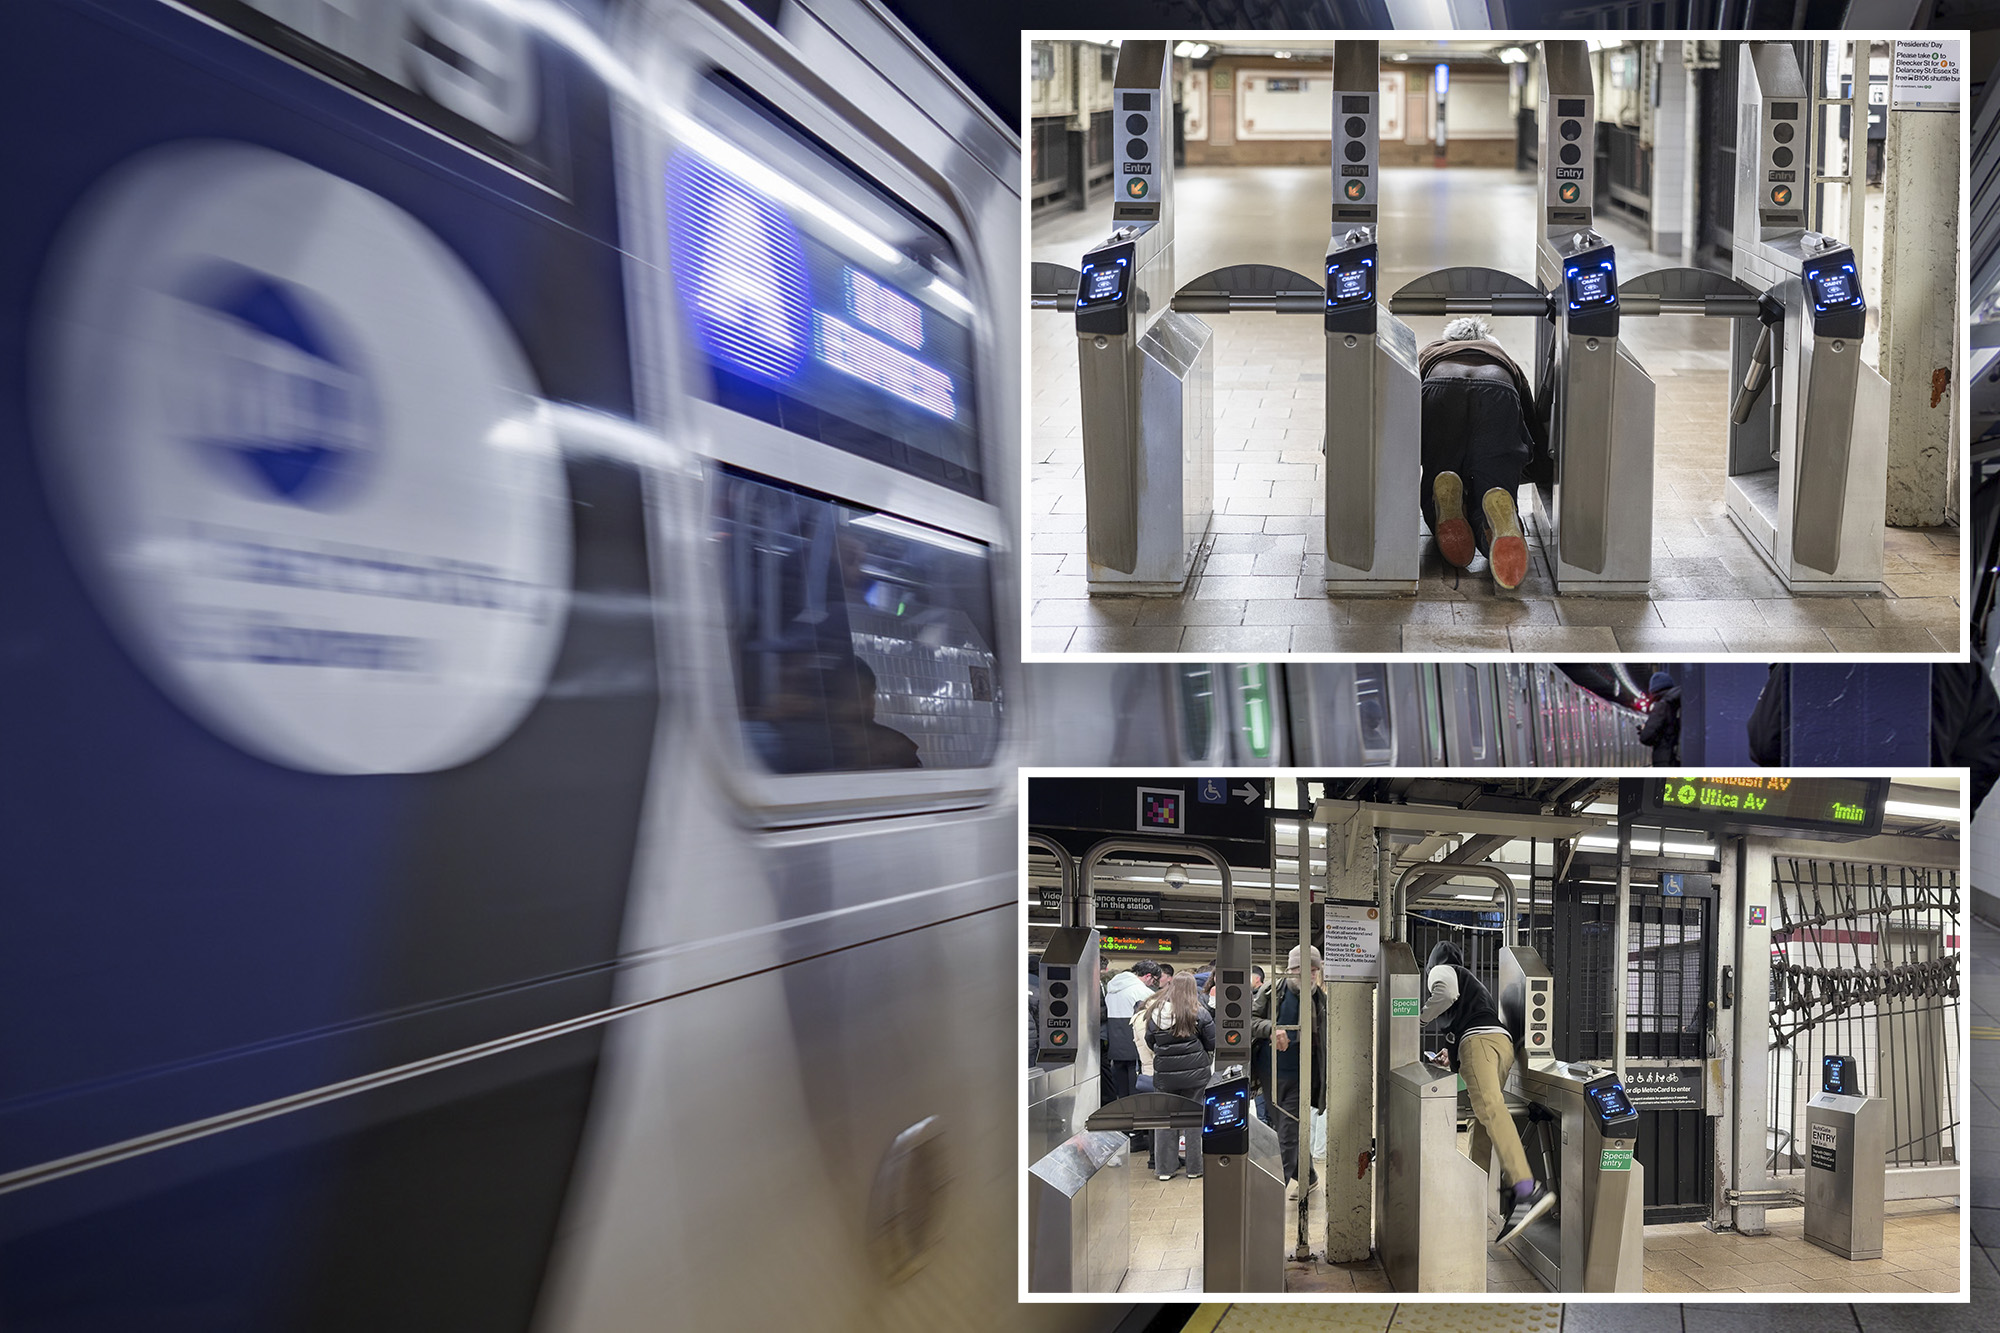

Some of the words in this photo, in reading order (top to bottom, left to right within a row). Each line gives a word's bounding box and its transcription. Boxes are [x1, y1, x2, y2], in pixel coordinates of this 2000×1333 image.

[1124, 163, 1151, 174] Entry
[1342, 165, 1367, 176] Entry
[1557, 168, 1583, 179] Entry
[1769, 170, 1794, 182] Entry
[1095, 274, 1115, 282] OMNY
[1341, 274, 1361, 282] OMNY
[1767, 777, 1791, 791] Av
[1700, 788, 1739, 808] Utica
[1743, 793, 1767, 810] Av
[1832, 802, 1864, 821] 1min
[1043, 892, 1061, 900] Vide
[1110, 901, 1125, 909] this
[1127, 902, 1154, 910] station
[1048, 1019, 1070, 1028] Entry
[1223, 1020, 1243, 1028] Entry
[1531, 1022, 1546, 1030] Entry
[1813, 1125, 1831, 1133] AutoGate
[1813, 1131, 1836, 1143] ENTRY
[1603, 1152, 1632, 1160] Special
[1602, 1159, 1623, 1168] entry
